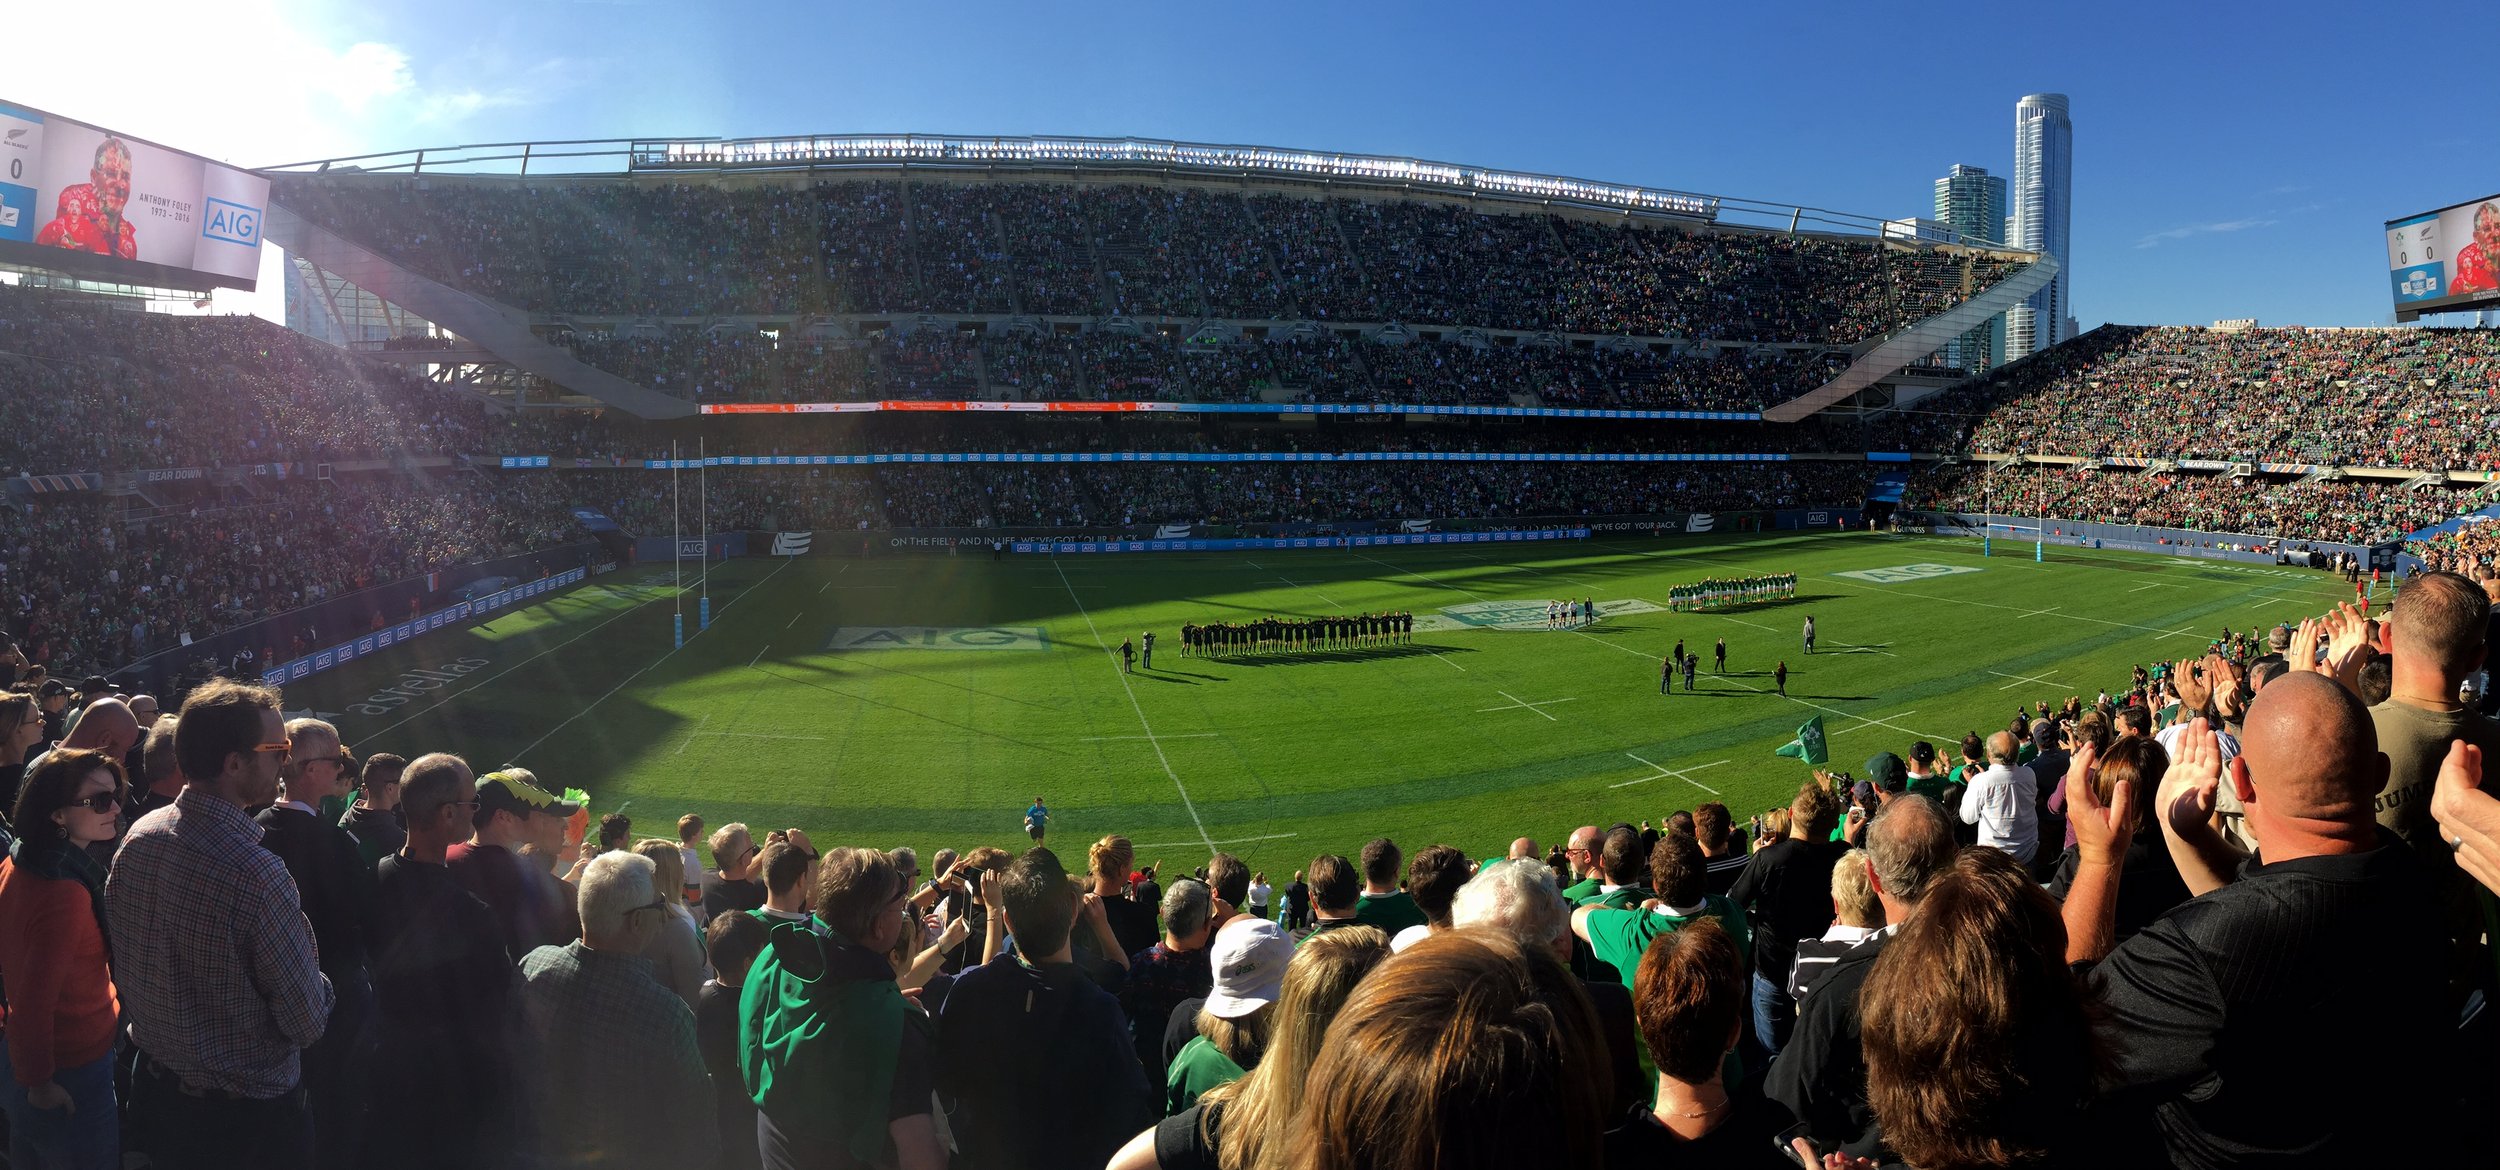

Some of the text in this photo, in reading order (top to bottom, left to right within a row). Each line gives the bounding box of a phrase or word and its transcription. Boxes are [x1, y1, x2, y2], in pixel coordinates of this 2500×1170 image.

[10, 158, 22, 180] 0
[139, 193, 192, 212] ANTHONY FOLEY
[151, 207, 166, 218] 1973
[175, 212, 190, 222] 2016
[210, 208, 253, 237] AIG
[2400, 252, 2407, 264] 0
[2426, 246, 2433, 260] 0
[148, 469, 202, 481] BEAR DOWN
[1810, 513, 1825, 522] AIG
[1897, 525, 1926, 535] GUINNESS
[891, 538, 907, 547] ON
[910, 537, 928, 546] THE
[931, 537, 953, 546] FIEL
[959, 537, 981, 545] AND
[984, 537, 994, 545] IN
[682, 543, 704, 553] AIG
[1862, 566, 1953, 580] AIG
[433, 617, 441, 625] AIG
[446, 612, 454, 620] AIG
[416, 622, 425, 631] AIG
[399, 628, 408, 637] AIG
[848, 630, 1018, 646] AIG
[380, 634, 390, 644] AIG
[361, 642, 371, 651] AIG
[340, 648, 351, 658] AIG
[318, 656, 329, 666] AIG
[294, 664, 307, 675] AIG
[269, 671, 282, 682] AIG
[346, 656, 490, 716] astellas
[2374, 780, 2431, 812] JUM
